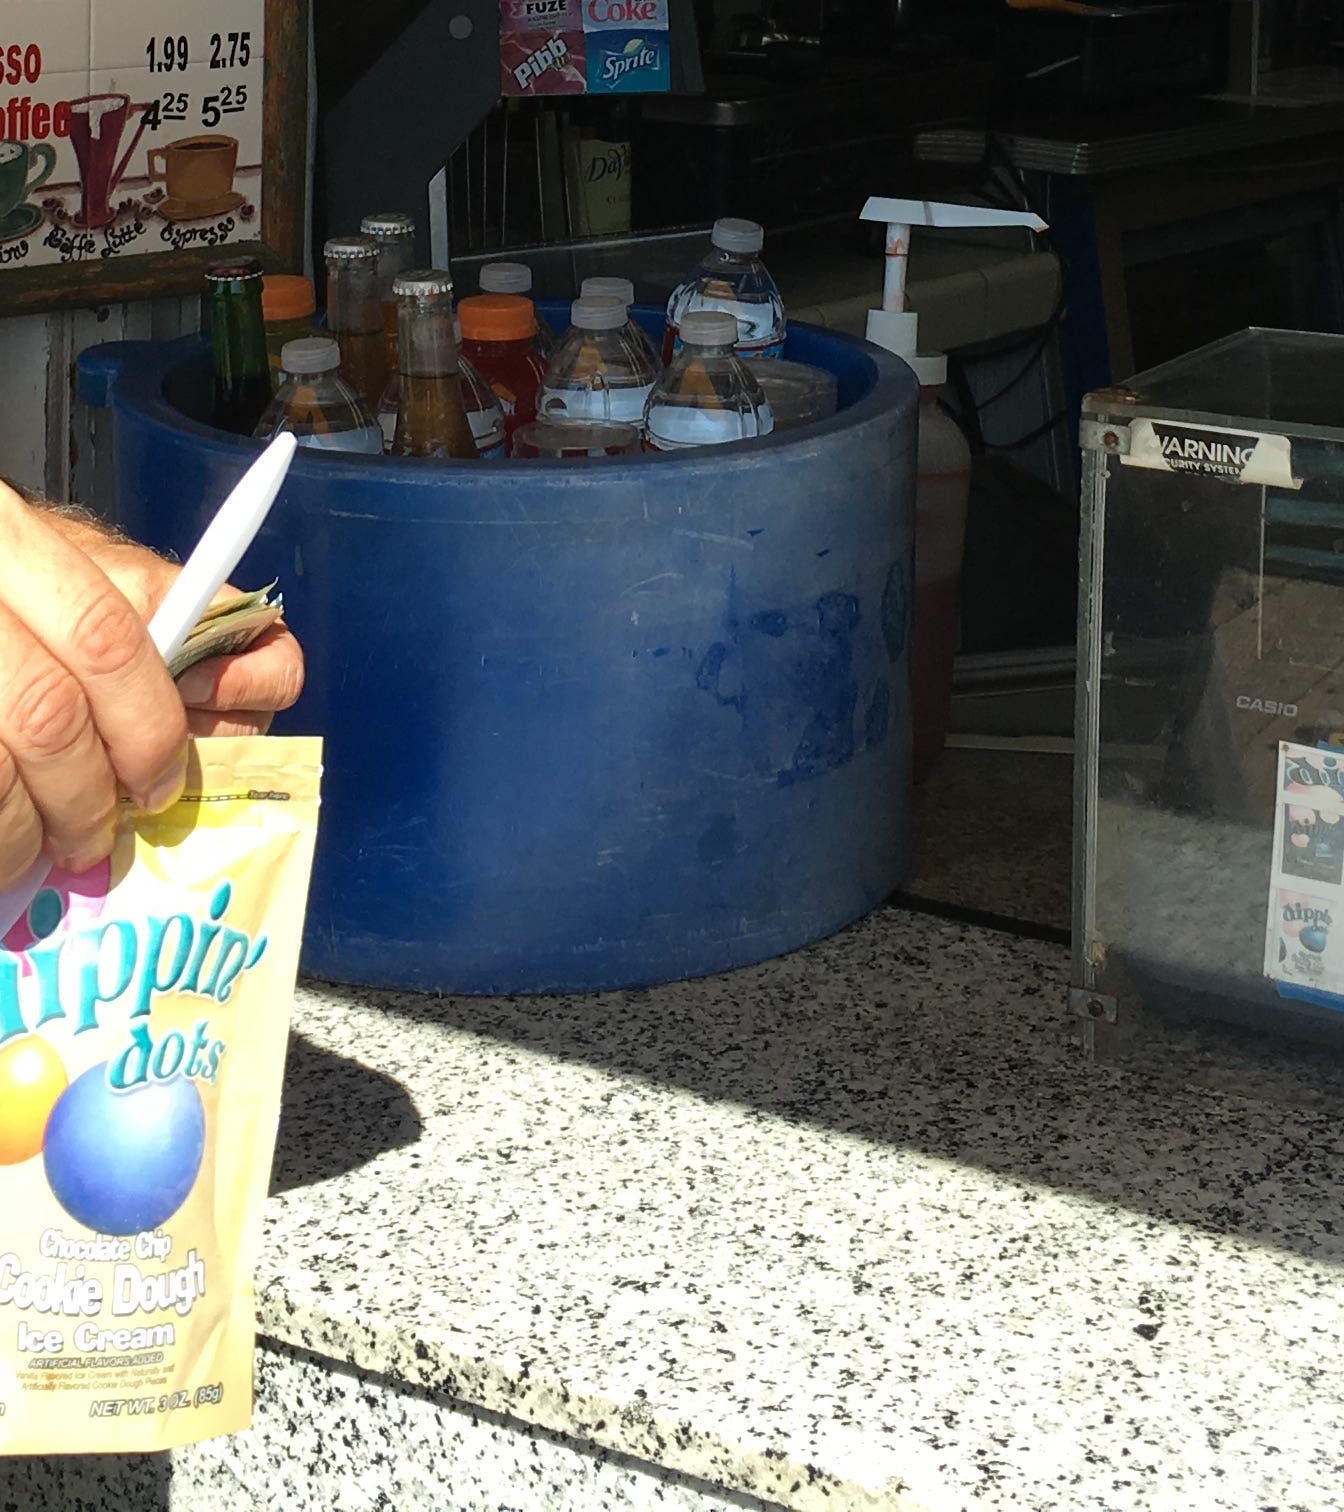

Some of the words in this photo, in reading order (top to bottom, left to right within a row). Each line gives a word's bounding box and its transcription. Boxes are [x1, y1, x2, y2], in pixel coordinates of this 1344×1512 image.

[526, 0, 567, 15] FUZE
[146, 36, 188, 73] 1.99
[209, 32, 251, 70] 2.75
[513, 37, 568, 89] Pibb
[603, 47, 655, 80] Sprite
[1236, 696, 1298, 717] CASIO
[106, 1019, 225, 1092] dots
[40, 1228, 131, 1262] Chocolate
[135, 1229, 172, 1263] Chip
[112, 1249, 206, 1317] Dough
[18, 1321, 64, 1352] Ice
[73, 1322, 175, 1352] Cream
[89, 1401, 126, 1417] NET
[194, 1382, 223, 1408] (85g)
